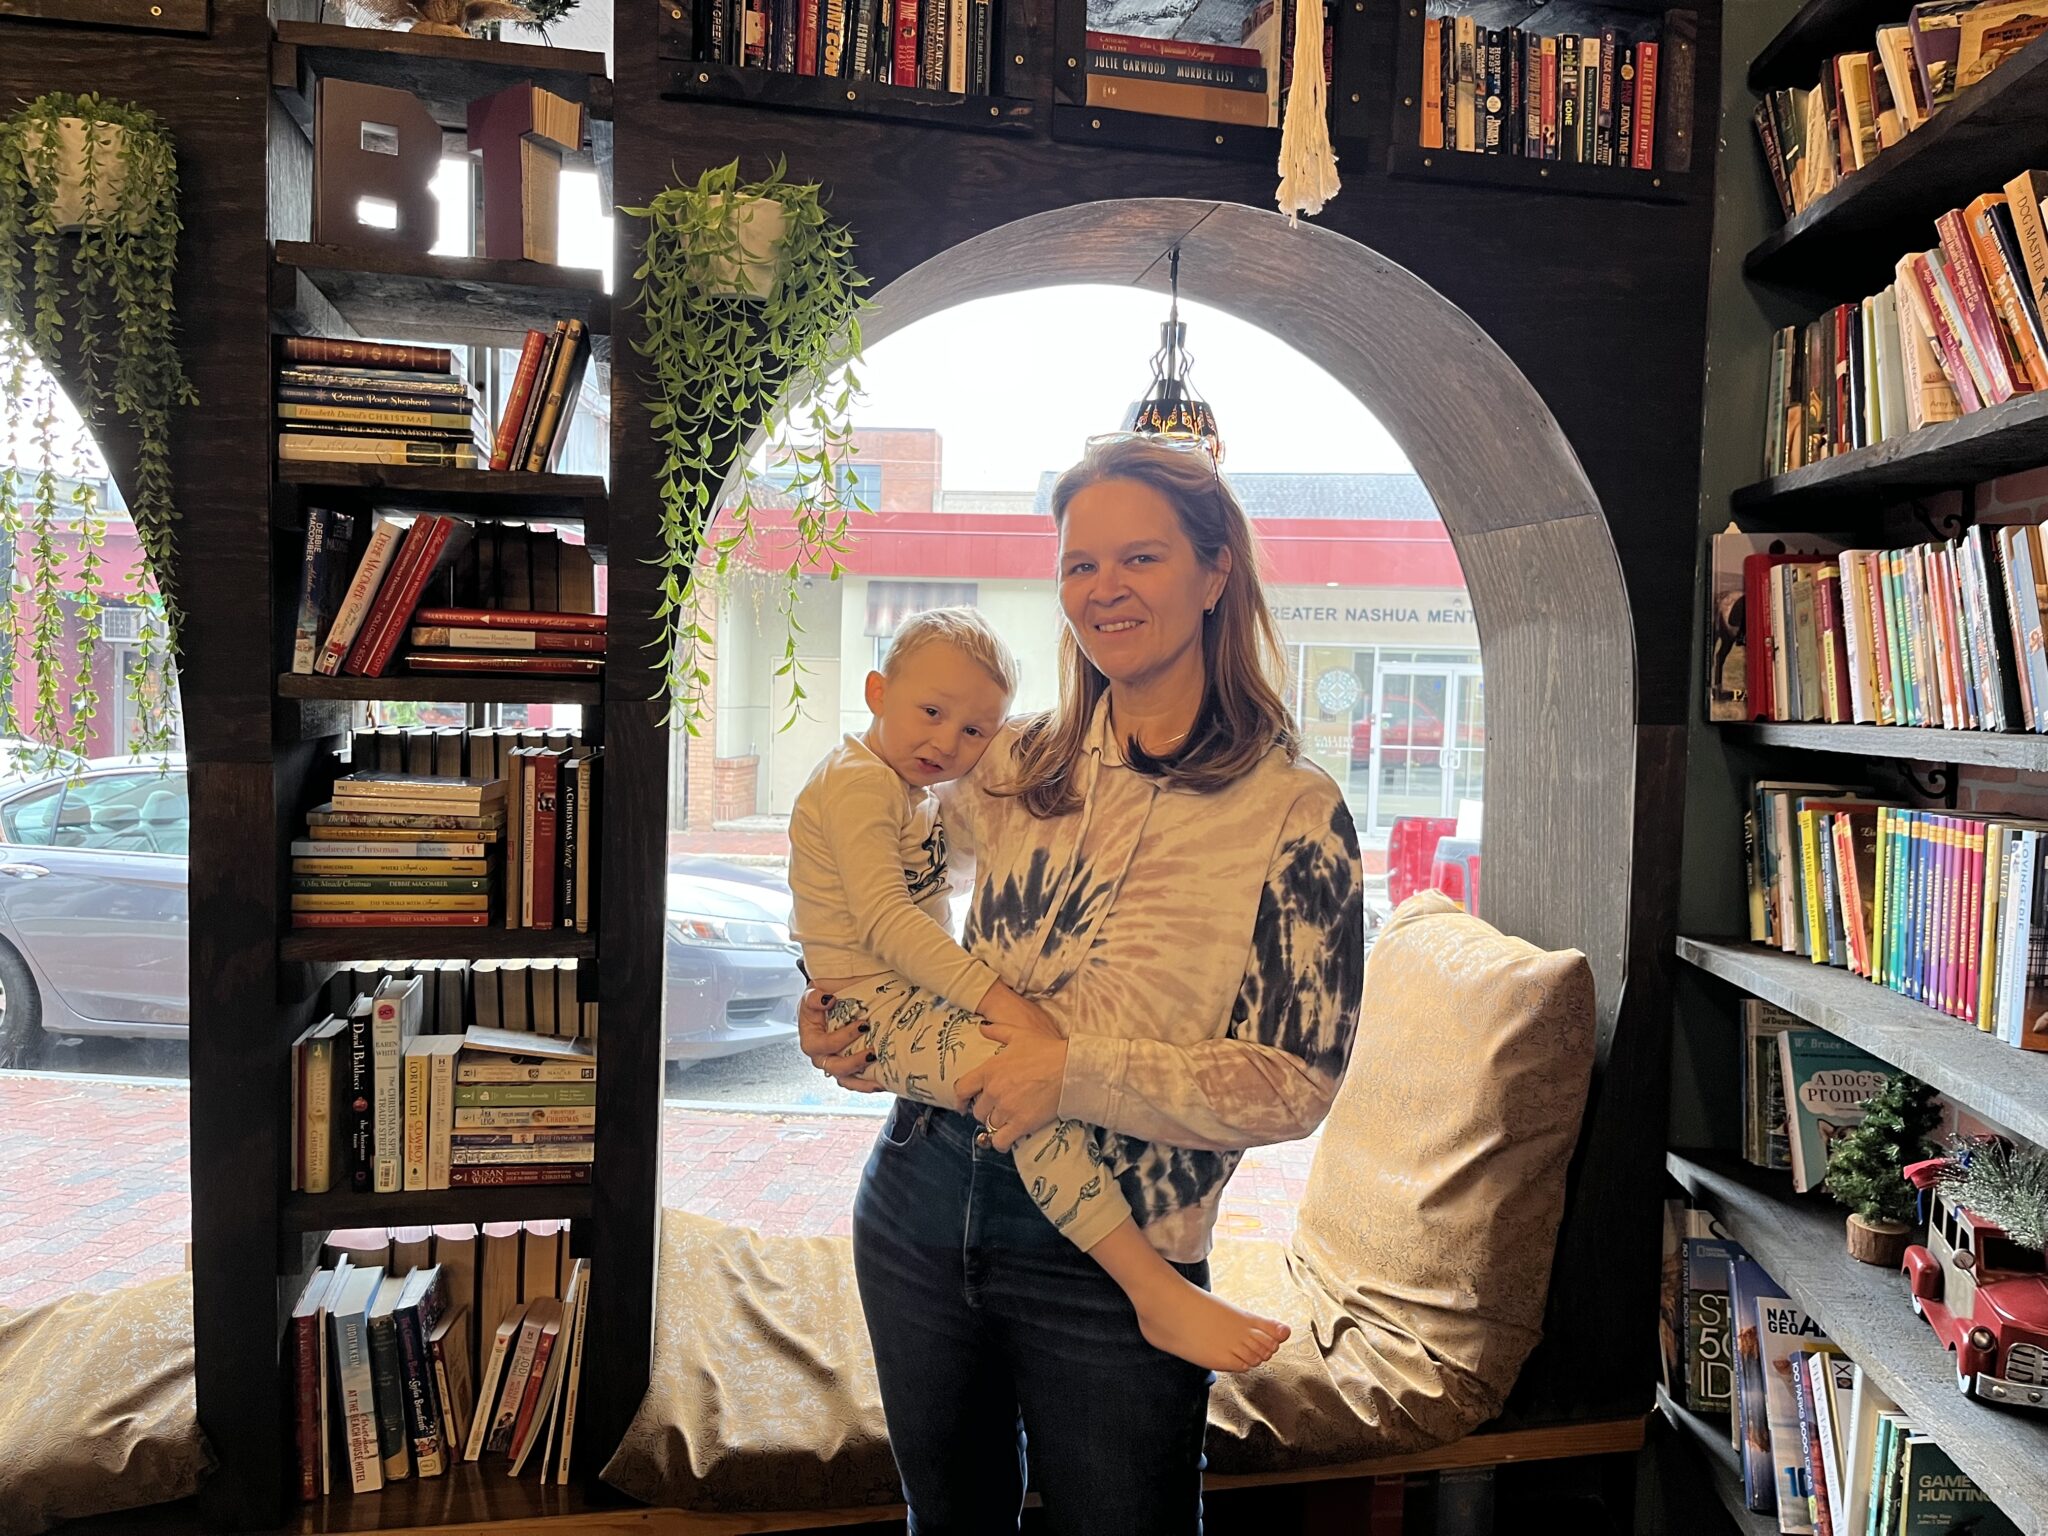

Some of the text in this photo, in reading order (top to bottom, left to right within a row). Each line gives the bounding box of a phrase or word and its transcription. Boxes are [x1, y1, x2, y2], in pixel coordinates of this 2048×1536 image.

[900, 2, 916, 21] TIME
[824, 32, 840, 78] CON
[1094, 55, 1235, 84] JULIE GARWOOD MURDER LIST
[1643, 57, 1654, 82] JULIE
[1564, 99, 1573, 126] GONE
[1620, 104, 1631, 135] JUDGING
[1641, 84, 1652, 127] GARWOOD
[1619, 136, 1629, 155] TIME
[2017, 195, 2046, 274] DOG MASTER
[1996, 275, 2022, 335] Pet Cures
[1949, 345, 1961, 366] Horse
[1956, 366, 1971, 392] Dancer
[331, 391, 431, 407] Certain Poor Shepherds
[299, 408, 428, 424] Elizabeth David's CHRISTMAS
[305, 512, 317, 562] MACOMBER
[314, 522, 324, 553] DEBBIE
[352, 532, 391, 600] DEBBIE MACOMBER
[496, 616, 530, 625] BECAUSE
[531, 617, 539, 625] OF
[1269, 607, 1475, 624] REATER NASHUA MENT
[352, 612, 385, 669] HOLLOWAY SCOTT
[1868, 585, 1886, 700] PERSONALITY DOG
[371, 651, 387, 672] SCOTT
[565, 792, 574, 840] CHRISTMAS
[357, 845, 400, 853] Christmas
[564, 840, 575, 870] Snow
[1804, 842, 1813, 877] MAKING
[1999, 854, 2010, 899] OLIVER
[2017, 840, 2030, 931] LOVING EDIE
[1924, 908, 1932, 951] FAMILIES
[1939, 877, 1950, 959] FANTASTIC FEATS
[1948, 878, 1959, 964] SECOND CHANCES
[1960, 895, 1968, 933] HEALING
[1968, 883, 1978, 970] FAMOUS ANIMALS
[1959, 933, 1967, 964] POWER
[352, 1022, 365, 1091] David Baldacci
[375, 1049, 398, 1057] WHITE
[1810, 1038, 1841, 1049] Bruce
[1815, 1073, 1883, 1087] A DOG'S
[378, 1097, 387, 1126] TRADD
[387, 1087, 397, 1136] CHRISTMAS
[409, 1061, 424, 1165] LORI WILDE COWBOY
[471, 1169, 504, 1177] SUSAN
[471, 1177, 504, 1185] WIGGS
[1767, 1308, 1797, 1323] NAT
[1768, 1322, 1799, 1335] GEO
[347, 1323, 358, 1350] JUDITH
[516, 1357, 532, 1377] JODI
[347, 1389, 366, 1483] AT THE BEACH HOUSE HOTEL
[1792, 1361, 1813, 1490] 100 PARKS 5000 IDEAS
[1919, 1475, 1971, 1488] GAME
